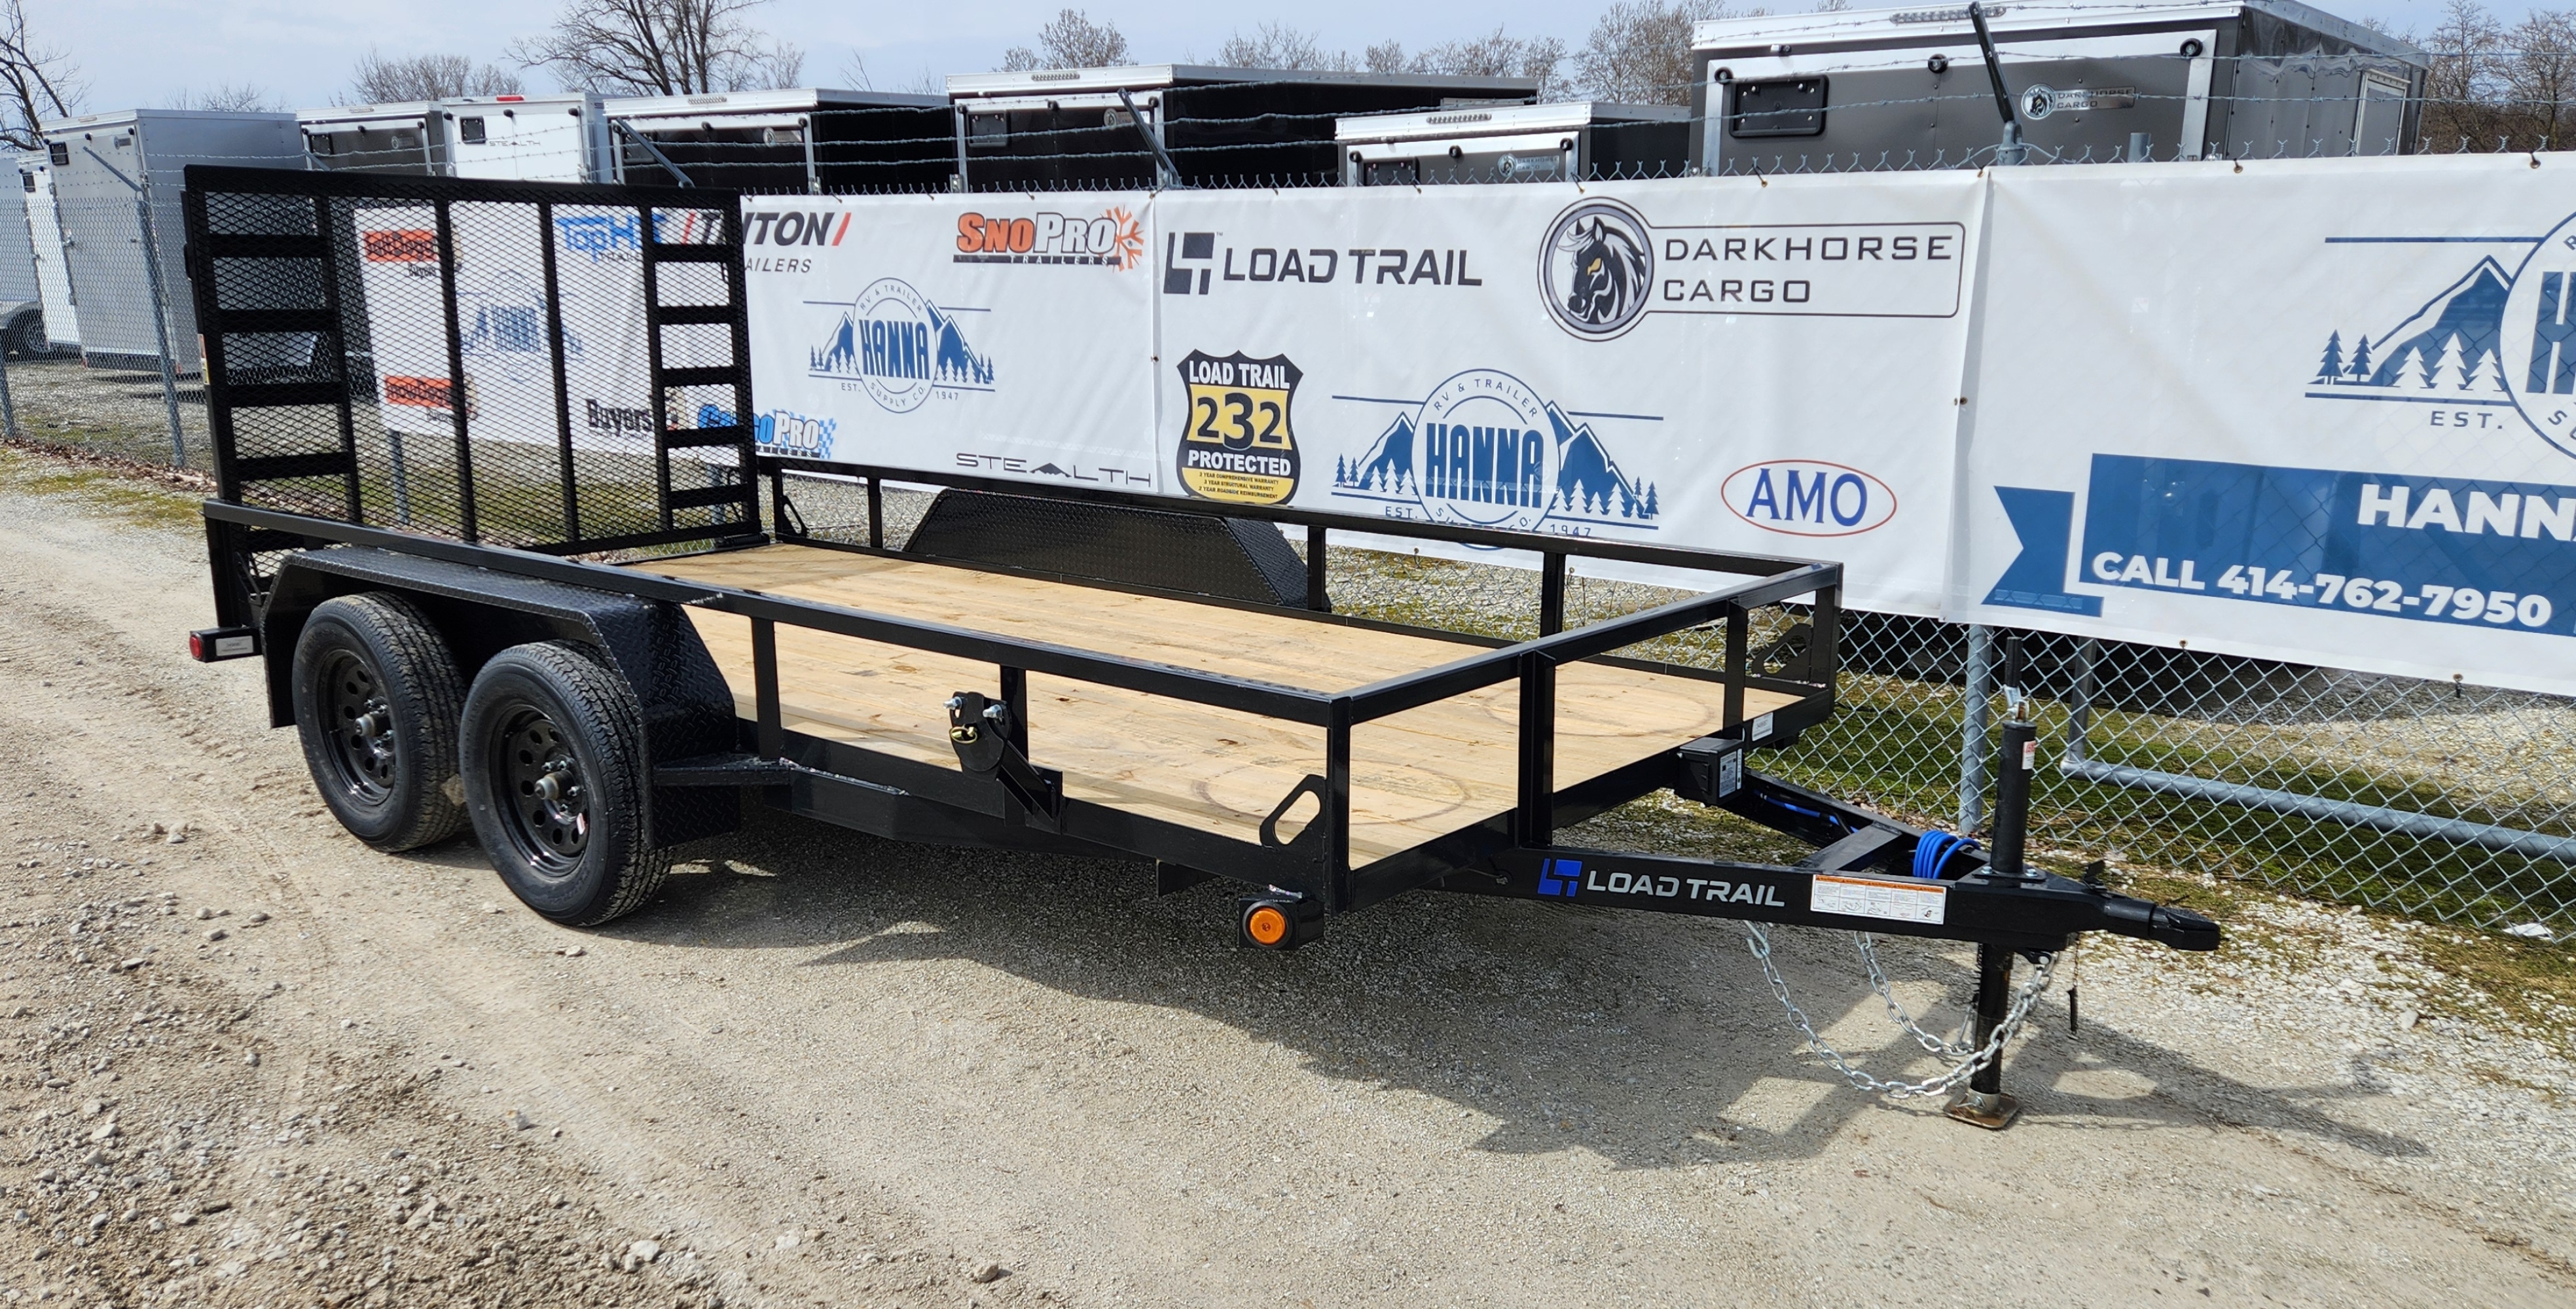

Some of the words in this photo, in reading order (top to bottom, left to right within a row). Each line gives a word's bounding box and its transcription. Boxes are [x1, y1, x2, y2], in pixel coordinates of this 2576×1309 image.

[2057, 101, 2098, 109] CARGO
[1010, 256, 1108, 265] TRAILERS
[1665, 235, 1953, 261] DARKHORSE
[1224, 247, 1338, 283] LOAD
[1349, 249, 1483, 286] TRAIL
[860, 296, 871, 311] RV
[884, 285, 922, 313] TRAILER
[1663, 279, 1811, 303] CARGO
[858, 319, 930, 380] HANNA
[1189, 360, 1234, 386] LOAD
[1239, 363, 1290, 390] TRAIL
[841, 383, 861, 392] EST.
[870, 382, 906, 406] SUPPLY
[913, 387, 926, 401] CO.
[936, 391, 959, 401] 1947
[1434, 392, 1450, 411] RV
[1458, 383, 1466, 392] &
[1474, 378, 1538, 417] TRAILER
[1197, 392, 1282, 449] 232
[2430, 410, 2503, 429] EST.
[1188, 450, 1291, 476] PROTECTED
[1216, 473, 1254, 482] COMPREHENSIVE
[1425, 422, 1544, 509] HANNA
[1221, 480, 1248, 489] STRUCTURAL
[1240, 490, 1278, 499] REIMBURSEMENT
[1745, 468, 1868, 526] AMO
[1385, 506, 1419, 518] EST.
[1550, 524, 1591, 537] 1947
[2357, 483, 2576, 542] HANN
[2093, 551, 2205, 590] CALL
[2217, 564, 2552, 628] 414-762-7950
[1587, 870, 1680, 897] LOAD
[1686, 878, 1785, 907] TRAIL
